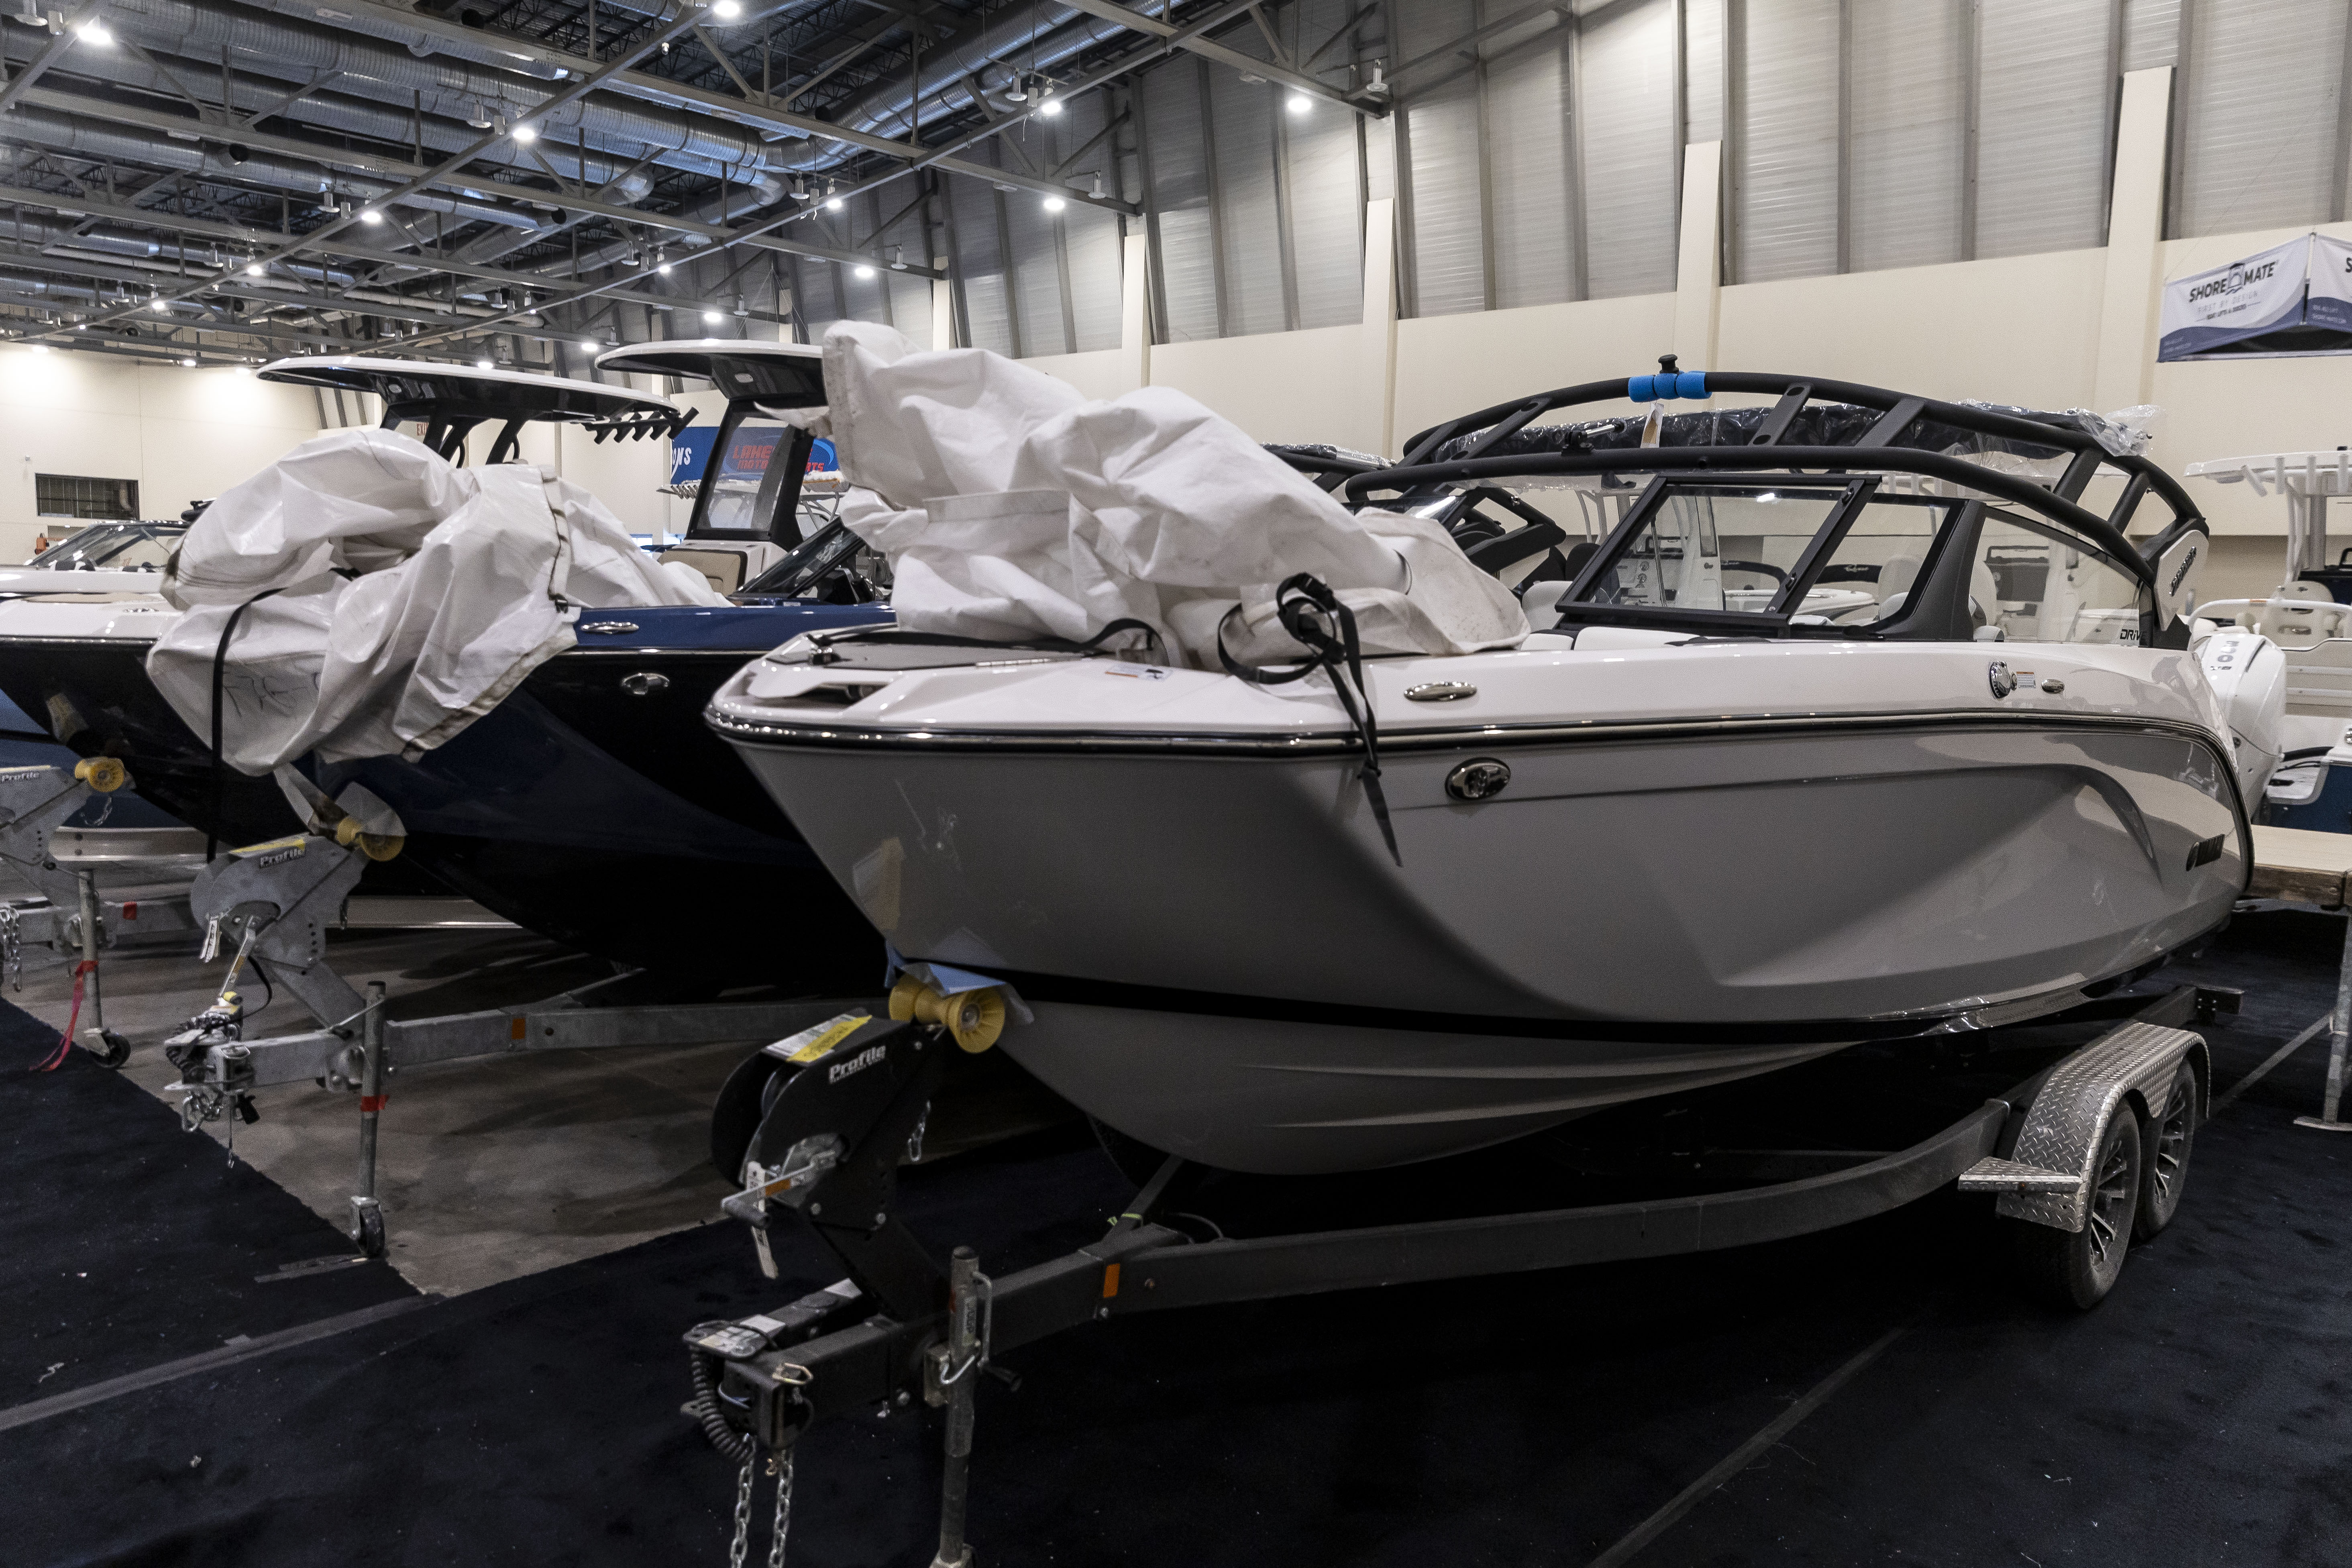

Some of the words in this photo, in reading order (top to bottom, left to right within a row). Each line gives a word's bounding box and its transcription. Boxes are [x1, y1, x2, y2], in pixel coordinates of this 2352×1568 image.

[2189, 278, 2227, 303] SHORE
[2244, 261, 2275, 285] MATE
[828, 1044, 887, 1085] Profile
